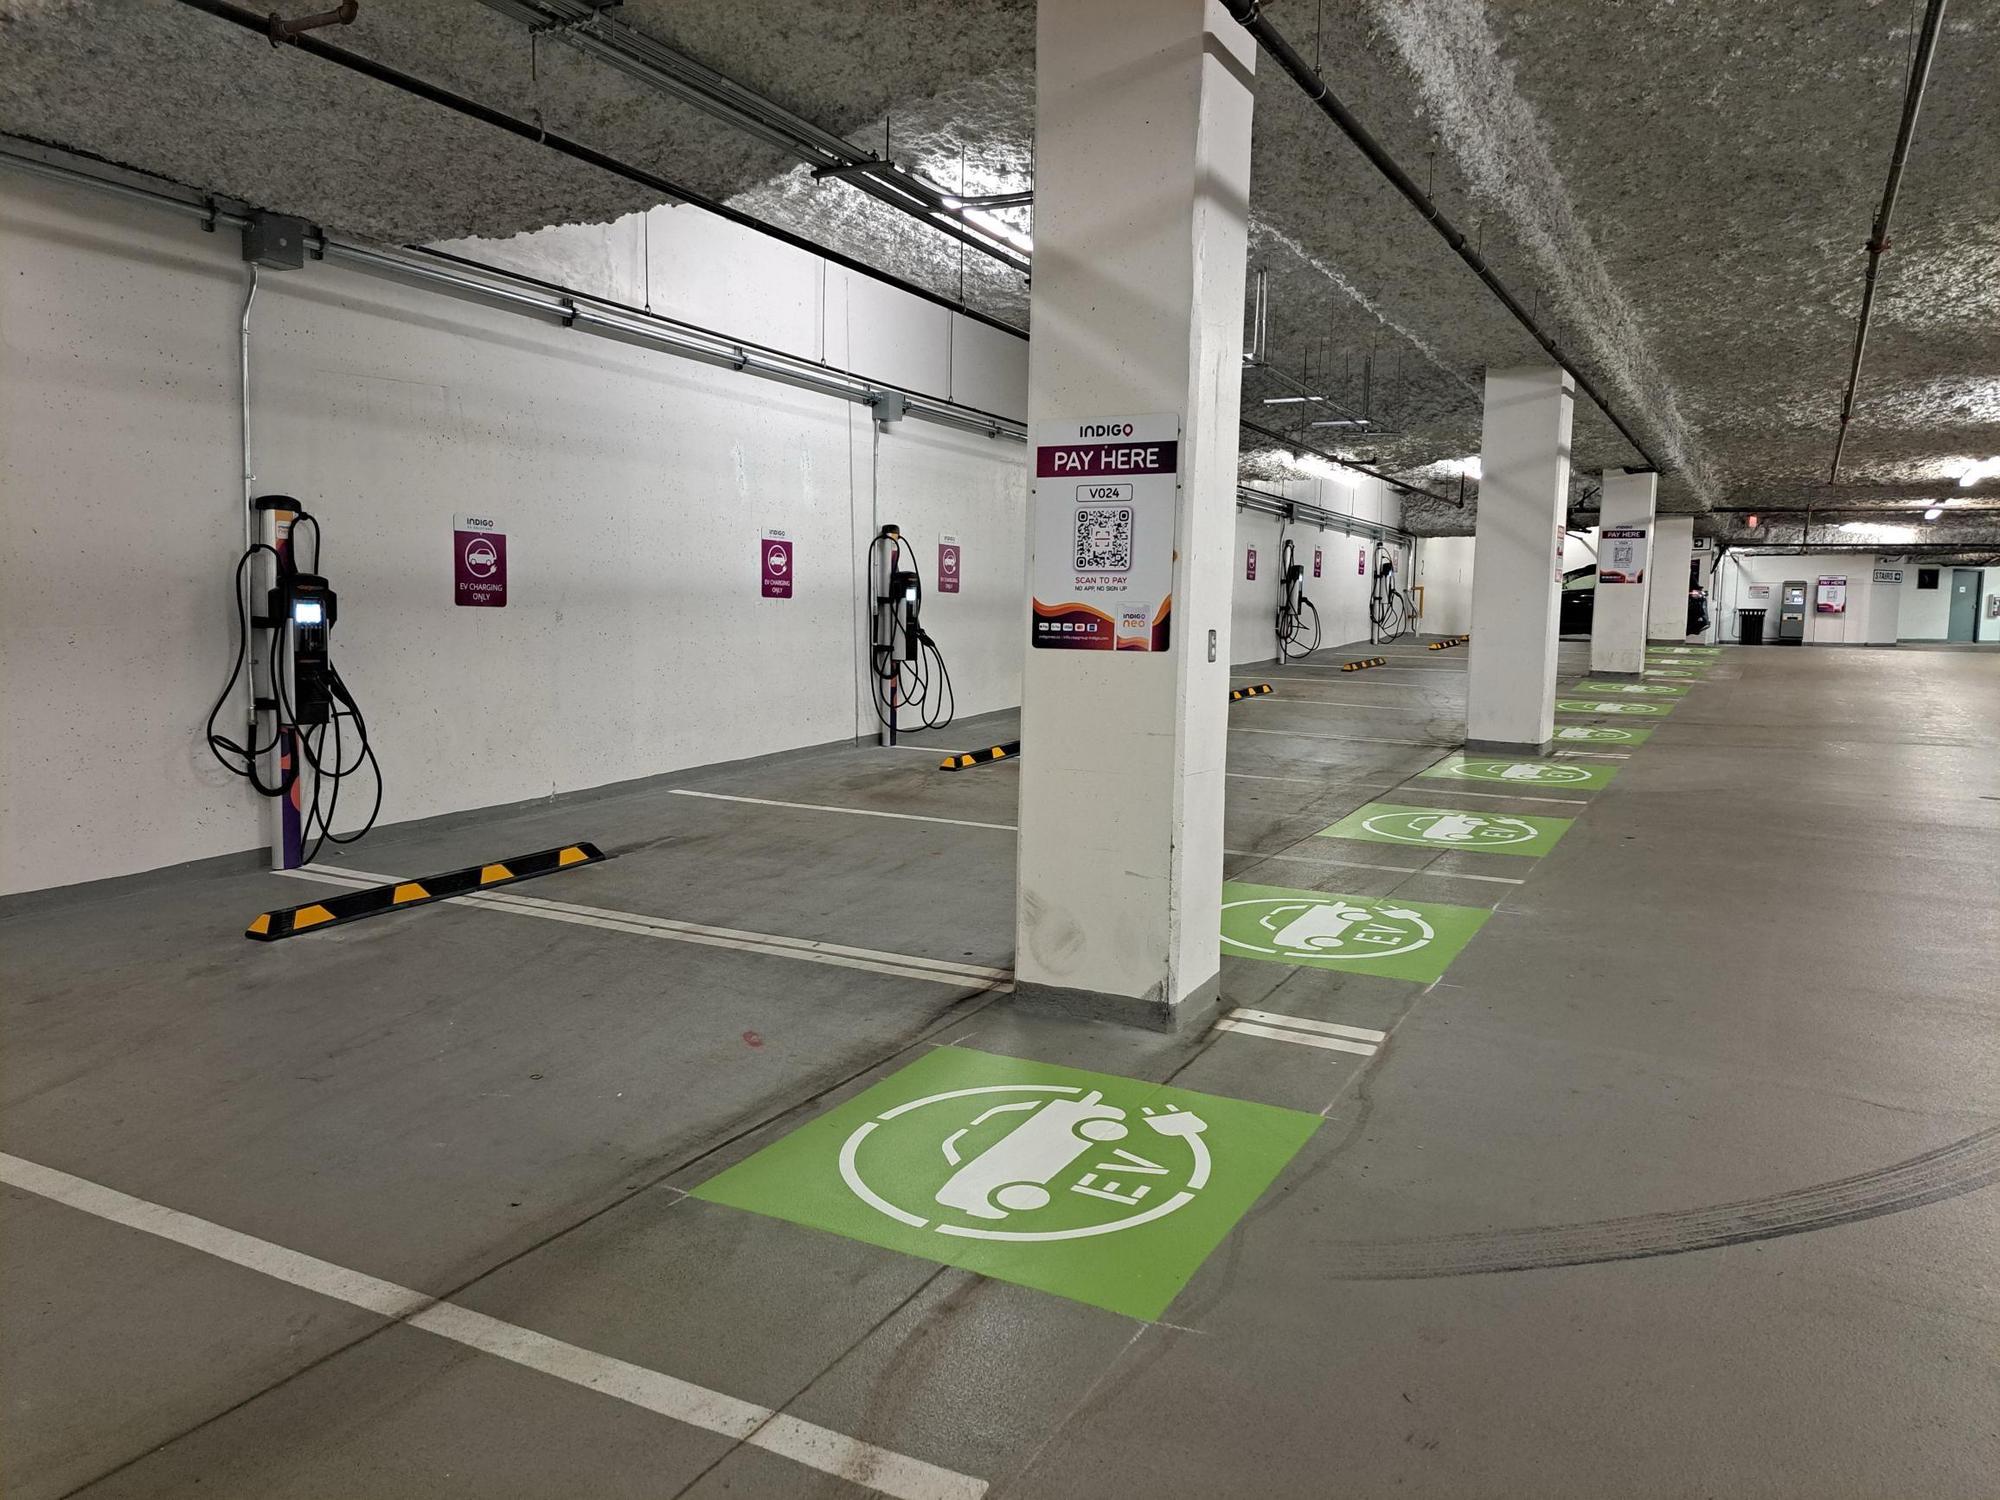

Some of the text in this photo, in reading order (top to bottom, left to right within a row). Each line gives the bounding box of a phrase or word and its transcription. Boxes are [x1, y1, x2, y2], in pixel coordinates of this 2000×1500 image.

[1079, 423, 1133, 438] INDIGO
[1054, 448, 1159, 471] PAY HERE
[1089, 487, 1120, 499] V024
[466, 517, 494, 527] INDIGO
[1075, 576, 1128, 584] SCAN TO PAY
[460, 582, 503, 592] EV CHARGING
[1122, 619, 1145, 628] neo
[1353, 923, 1408, 946] EV
[1070, 1148, 1170, 1205] EV
